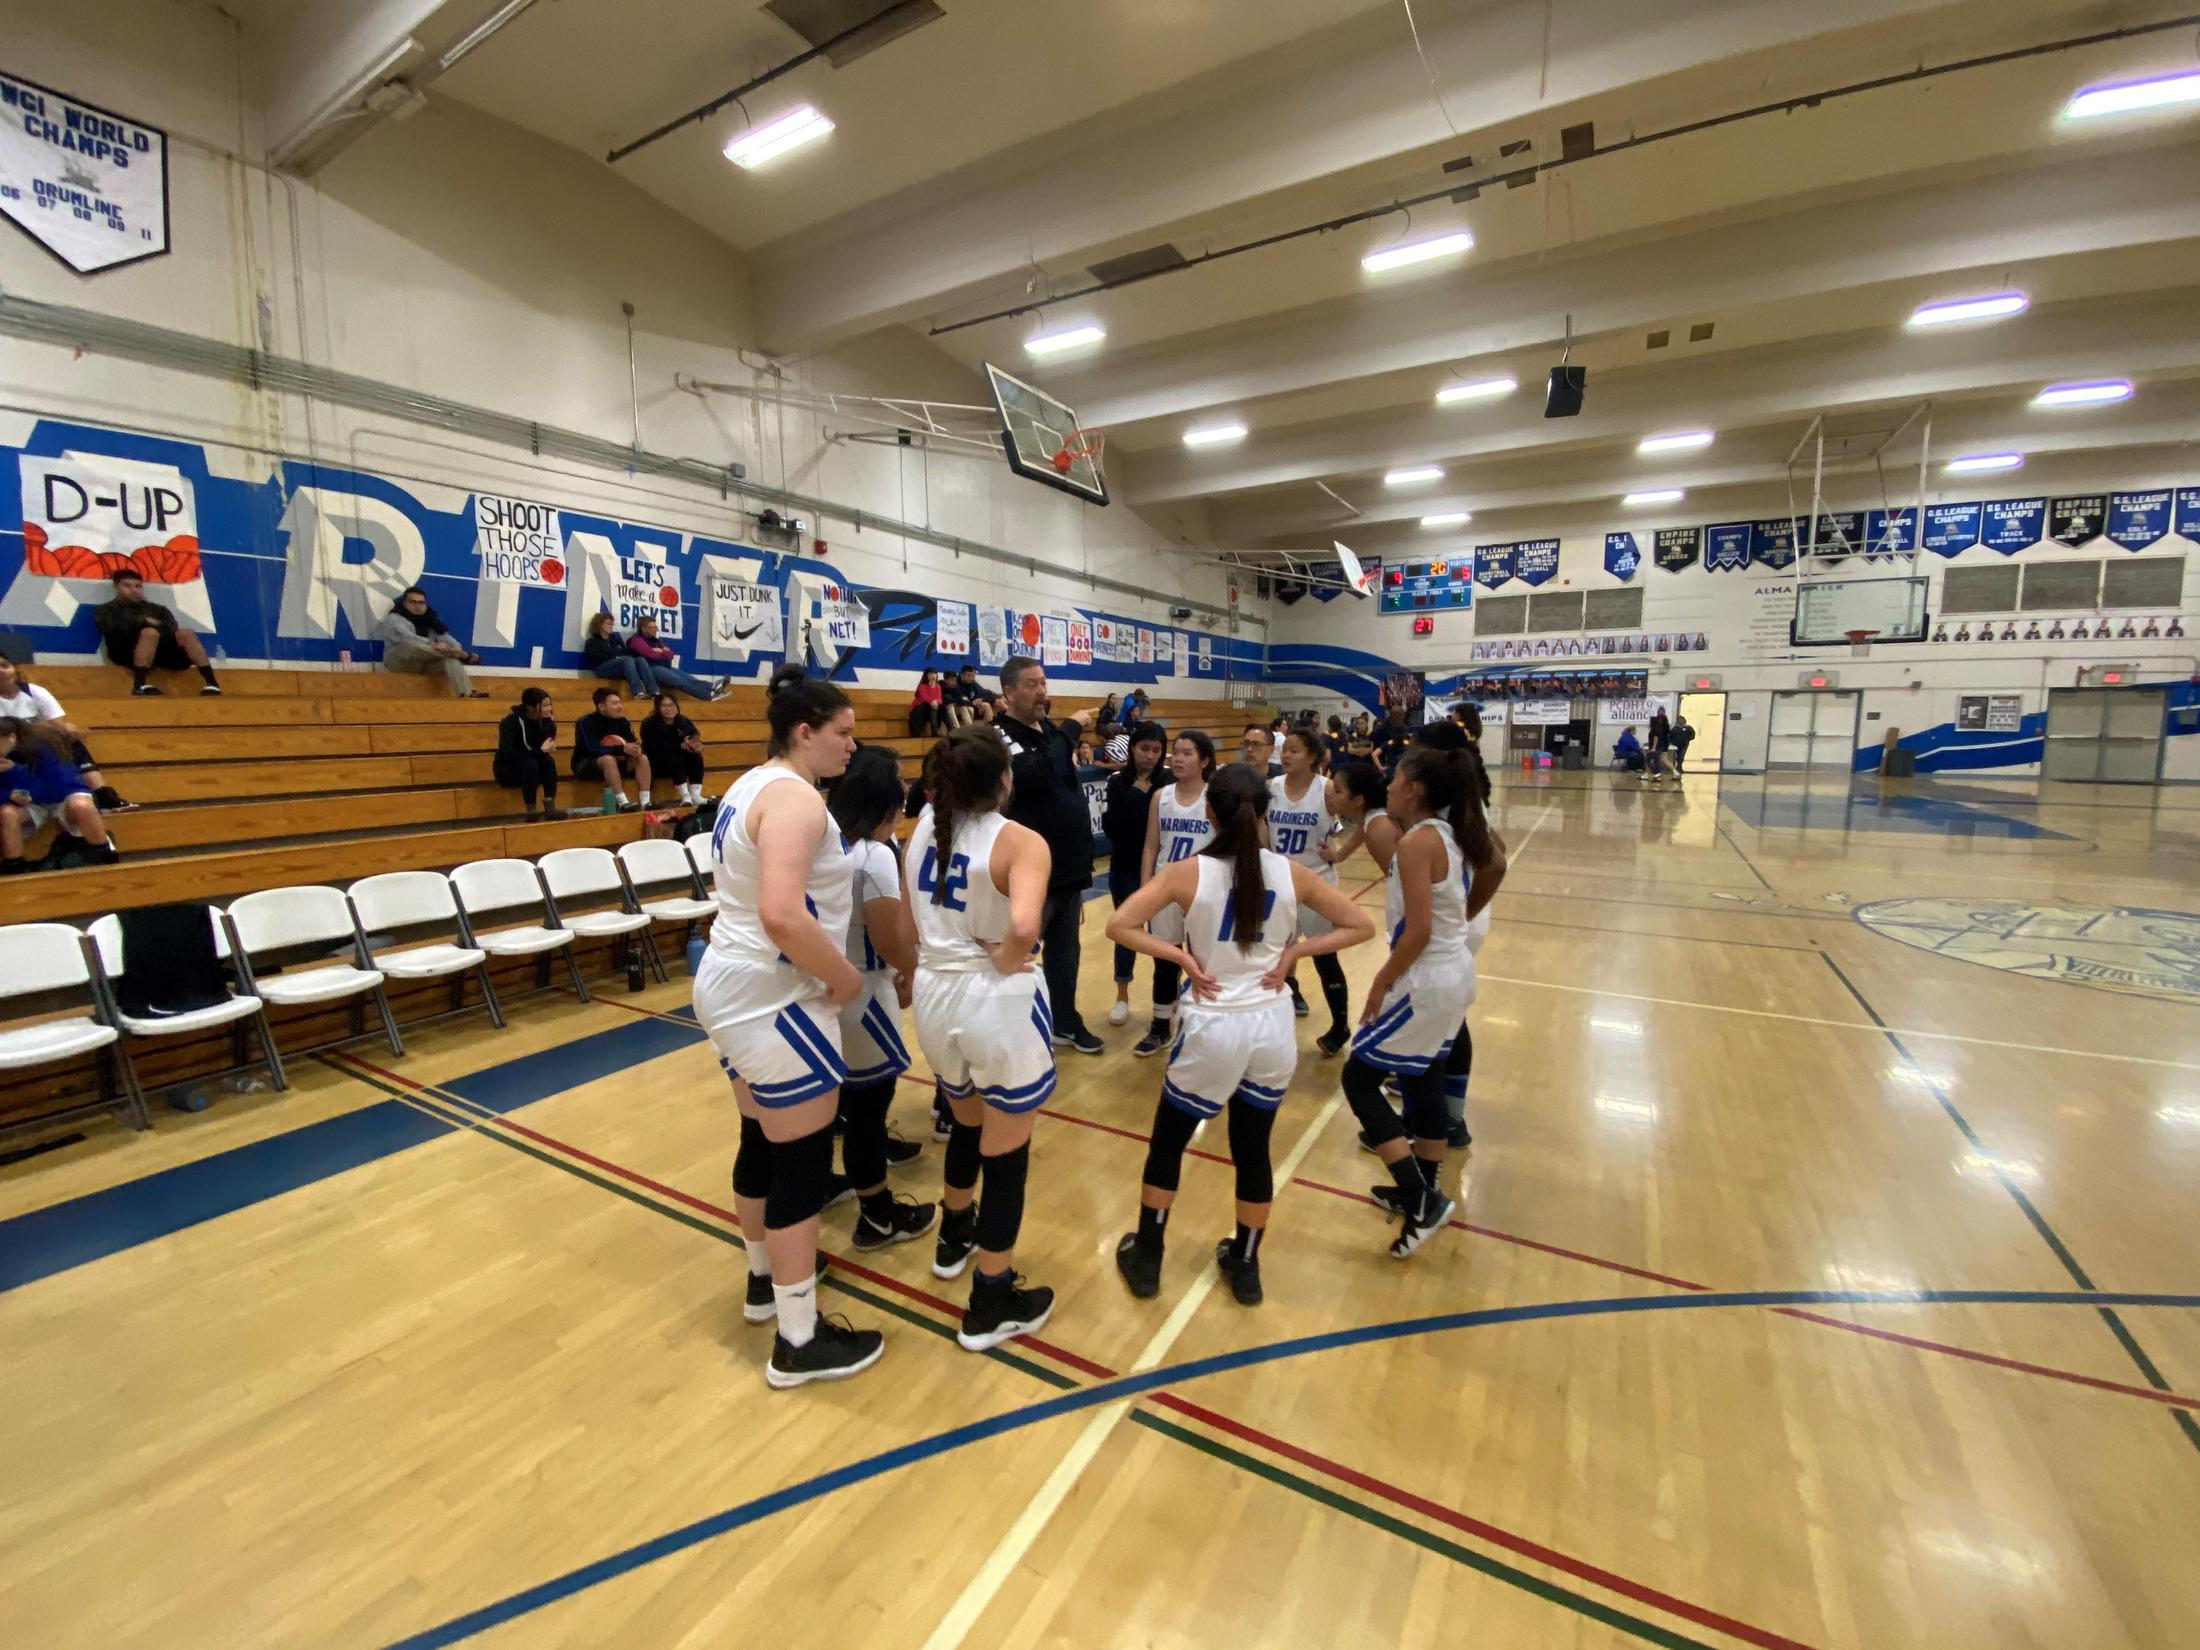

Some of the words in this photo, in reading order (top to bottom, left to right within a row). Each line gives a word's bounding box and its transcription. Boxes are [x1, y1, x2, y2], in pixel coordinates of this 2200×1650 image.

[64, 106, 150, 153] WORLD
[24, 114, 129, 168] CHAMPS
[33, 178, 123, 220] DRUMLINE
[44, 473, 183, 531] D-UP
[1944, 506, 1979, 516] LEAGUE
[2005, 500, 2044, 511] LEAGUE
[2120, 502, 2161, 512] CHAMPS
[479, 496, 556, 535] SHOOT
[1934, 514, 1970, 524] CHAMPS
[1993, 509, 2034, 520] CHAMPS
[479, 526, 558, 558] THOSE
[1764, 529, 1798, 537] CHAMP
[1524, 548, 1552, 557] CHAMPS
[1531, 541, 1558, 550] LEAGUE
[485, 551, 540, 581] HOOPS
[620, 557, 665, 588] LET'S
[716, 583, 748, 602] JUST
[750, 589, 774, 604] DUNK
[1754, 586, 1792, 595] ALMA
[829, 621, 857, 640] NET!
[1415, 618, 1433, 632] 27
[1611, 710, 1651, 720] allianc
[1160, 817, 1210, 834] MARINERS
[1269, 810, 1319, 826] MARINERS
[1167, 836, 1194, 863] 10
[1276, 828, 1308, 855] 30
[918, 845, 970, 912] 42
